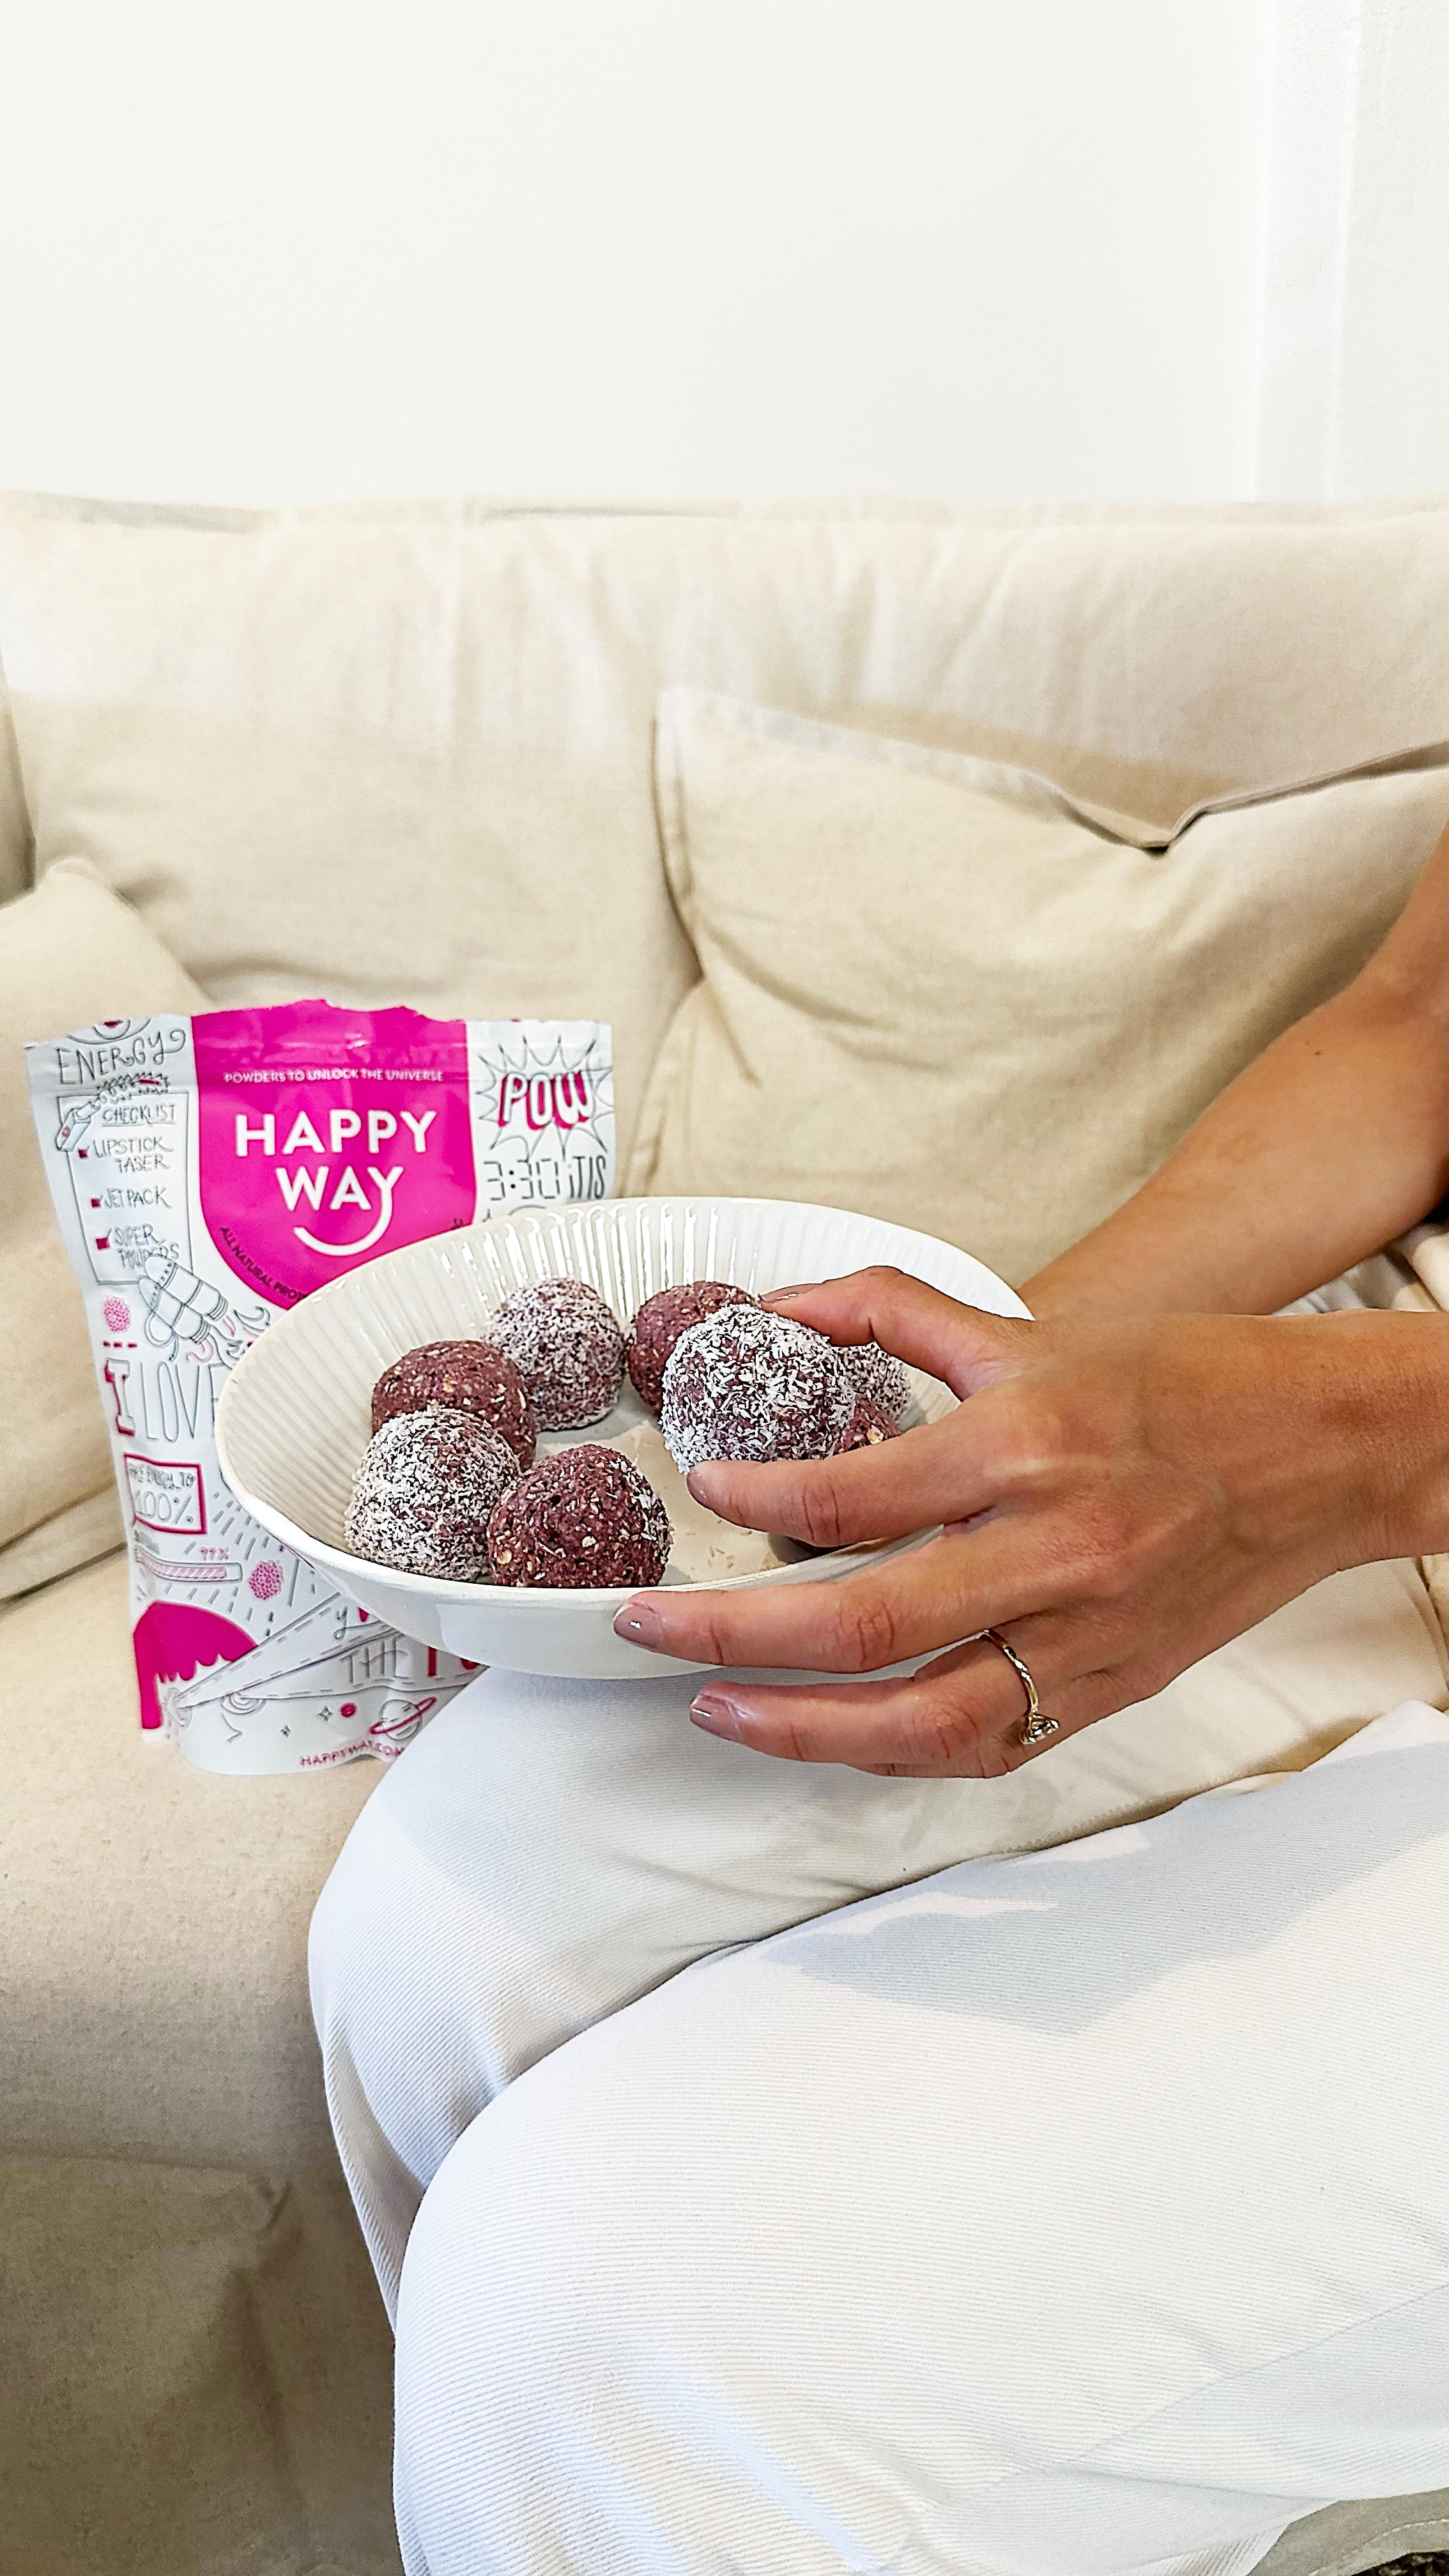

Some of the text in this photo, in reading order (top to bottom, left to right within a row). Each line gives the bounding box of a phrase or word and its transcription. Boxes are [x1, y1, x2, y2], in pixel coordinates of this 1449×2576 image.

[56, 1028, 186, 1085] ENERGY
[224, 1068, 443, 1084] POWDERS TO UNLOCK THE UNIVERSE
[102, 1103, 176, 1124] CHECKLIST
[498, 1071, 595, 1130] POW
[93, 1135, 174, 1158] LIPSTICK
[234, 1108, 437, 1157] HAPPY
[114, 1154, 171, 1174] TASER
[218, 1227, 236, 1246] ALL
[232, 1246, 273, 1286] NATURAL
[135, 1491, 194, 1525] 100%
